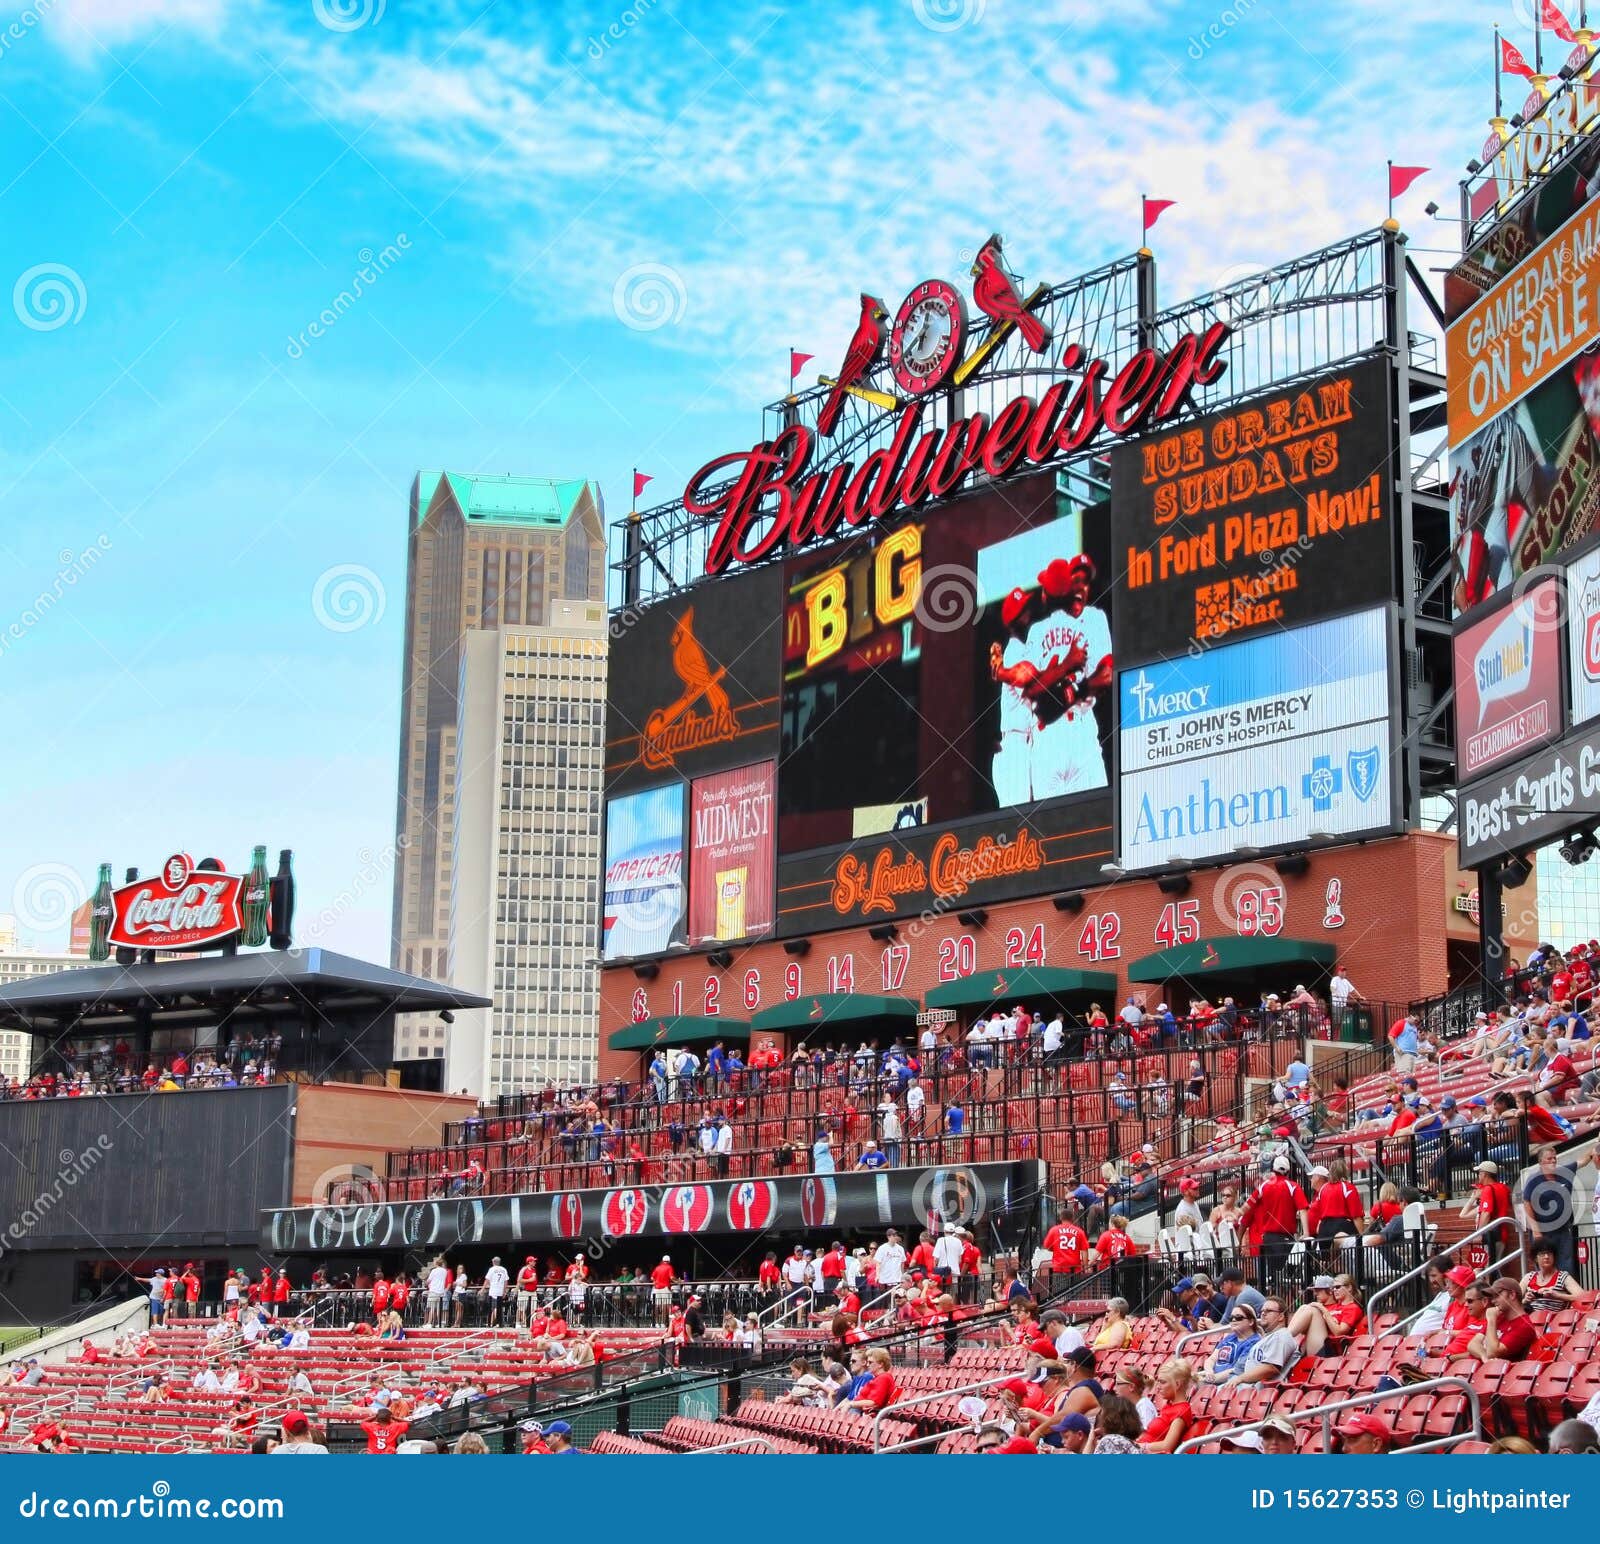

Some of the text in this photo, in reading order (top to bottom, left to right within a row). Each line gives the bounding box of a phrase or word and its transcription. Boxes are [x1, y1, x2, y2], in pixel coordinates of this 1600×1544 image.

[1483, 139, 1500, 158] 1926
[1467, 239, 1567, 358] GAMEDAY
[1468, 273, 1588, 417] ON SALE
[683, 321, 1235, 577] Budweiser
[1141, 378, 1353, 485] ICE CREAM
[1154, 431, 1339, 525] SUNDAYS
[1127, 473, 1381, 589] In Ford Plaza Now!
[1232, 565, 1298, 599] North
[1478, 621, 1530, 692] StubHub!
[639, 708, 742, 770] Cardinals
[1147, 694, 1313, 746] ST. JOHN'S MERCY
[1147, 718, 1296, 760] CHILDREN'S HOSPITAL
[694, 793, 773, 849] MIDWEST
[1129, 779, 1292, 846] Anthem
[1465, 787, 1512, 848] Best
[1514, 758, 1575, 826] Cards
[607, 850, 684, 883] American
[930, 827, 1047, 897] Cardinals
[1078, 911, 1121, 962] 42
[1154, 898, 1201, 949] 45
[1236, 886, 1284, 938] 85
[881, 943, 910, 991] 17
[938, 934, 977, 983] 20
[1005, 922, 1046, 968] 24
[672, 980, 683, 1016] 1
[704, 975, 720, 1016] 2
[743, 968, 760, 1010] 6
[784, 962, 801, 1001] 9
[827, 953, 855, 994] 14
[1059, 1235, 1076, 1251] 24
[1470, 1252, 1485, 1263] 127
[376, 1438, 386, 1450] 5
